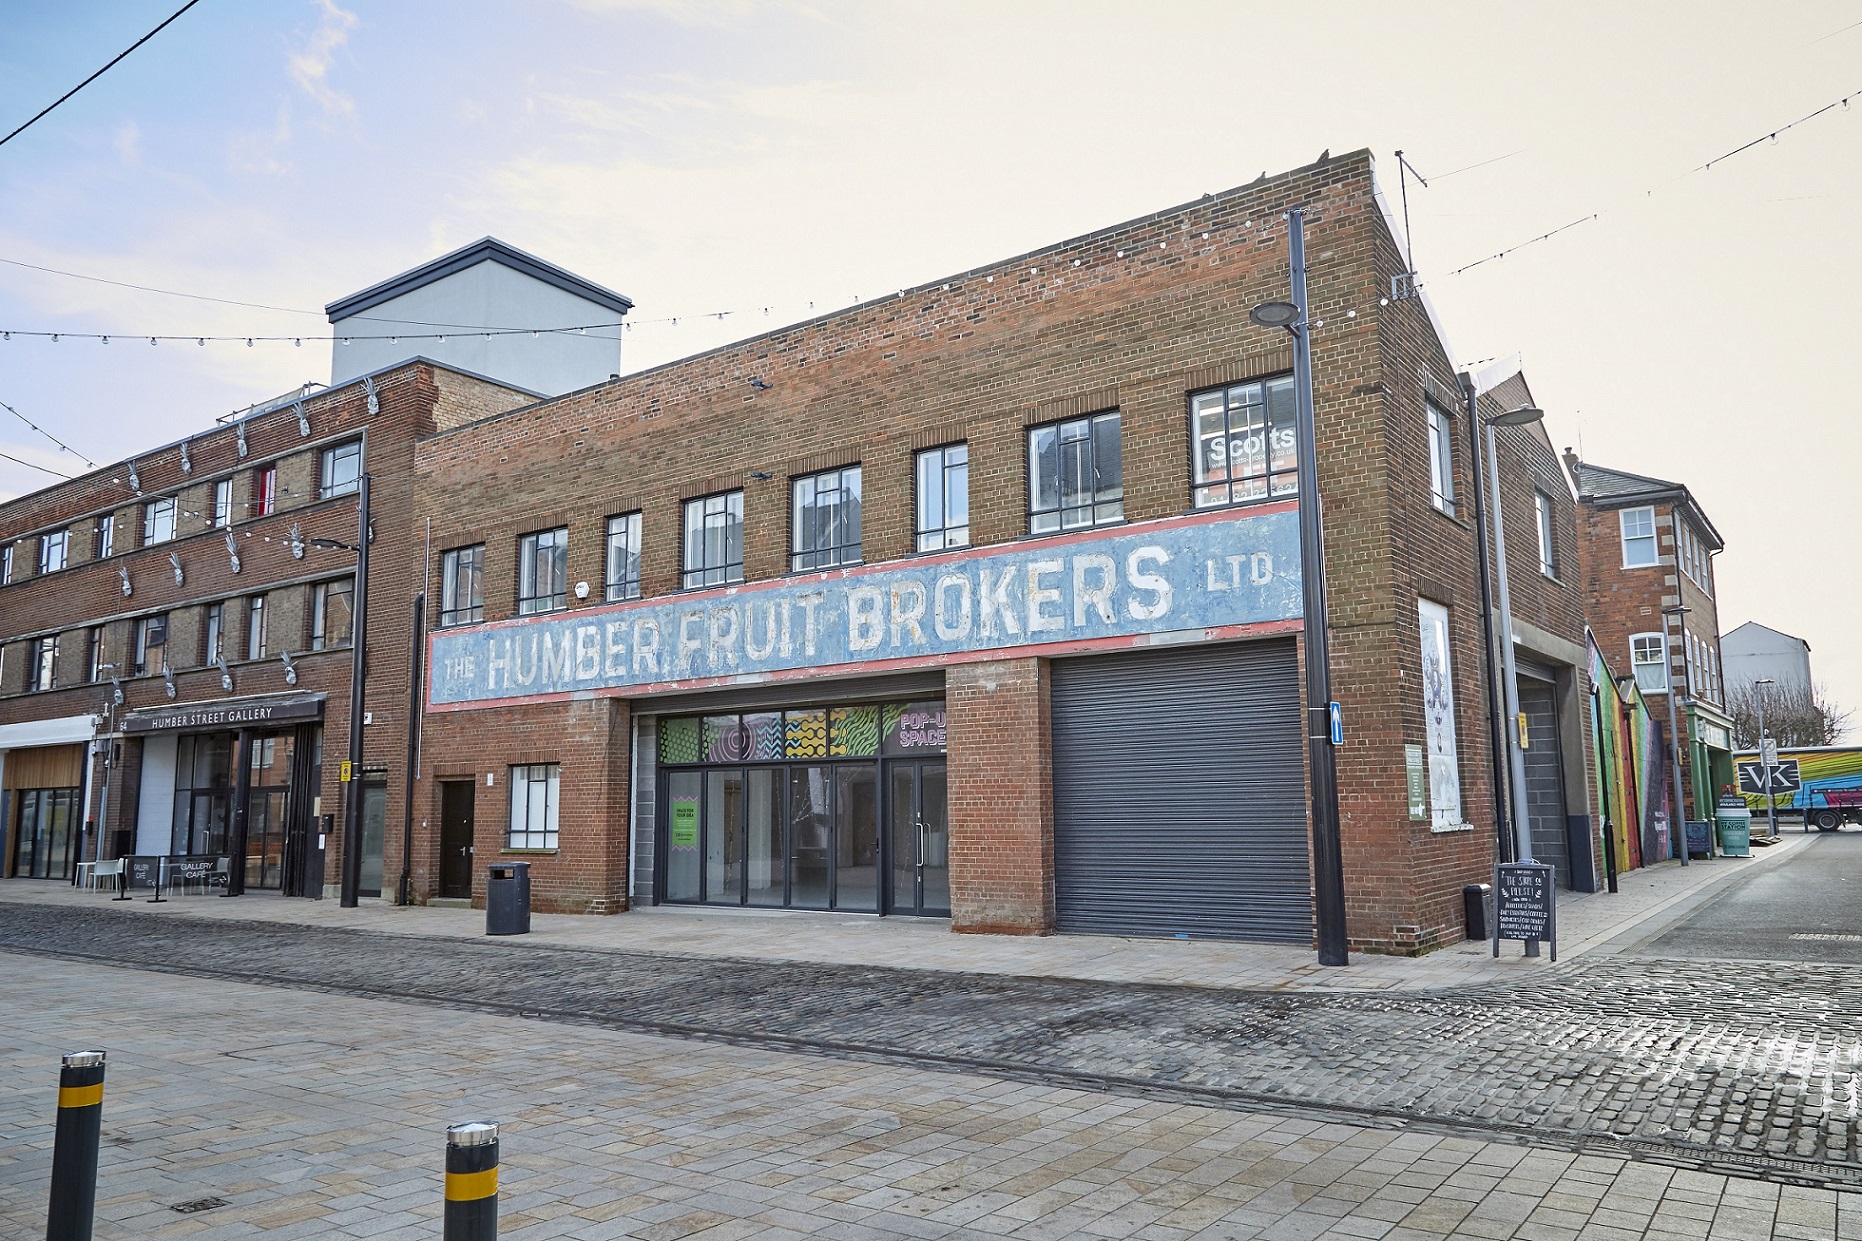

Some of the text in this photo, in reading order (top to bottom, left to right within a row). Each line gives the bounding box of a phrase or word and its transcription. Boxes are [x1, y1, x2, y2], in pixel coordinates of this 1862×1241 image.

[1210, 427, 1295, 461] Scotts
[444, 545, 1274, 690] THE HUMBER FRUIT BROKERS LTD
[119, 707, 273, 731] 64 HUMBER STREET GALLERY
[900, 711, 947, 730] POP-U
[900, 728, 947, 747] SPACE
[1743, 764, 1795, 789] VK
[180, 862, 213, 871] GALLERY
